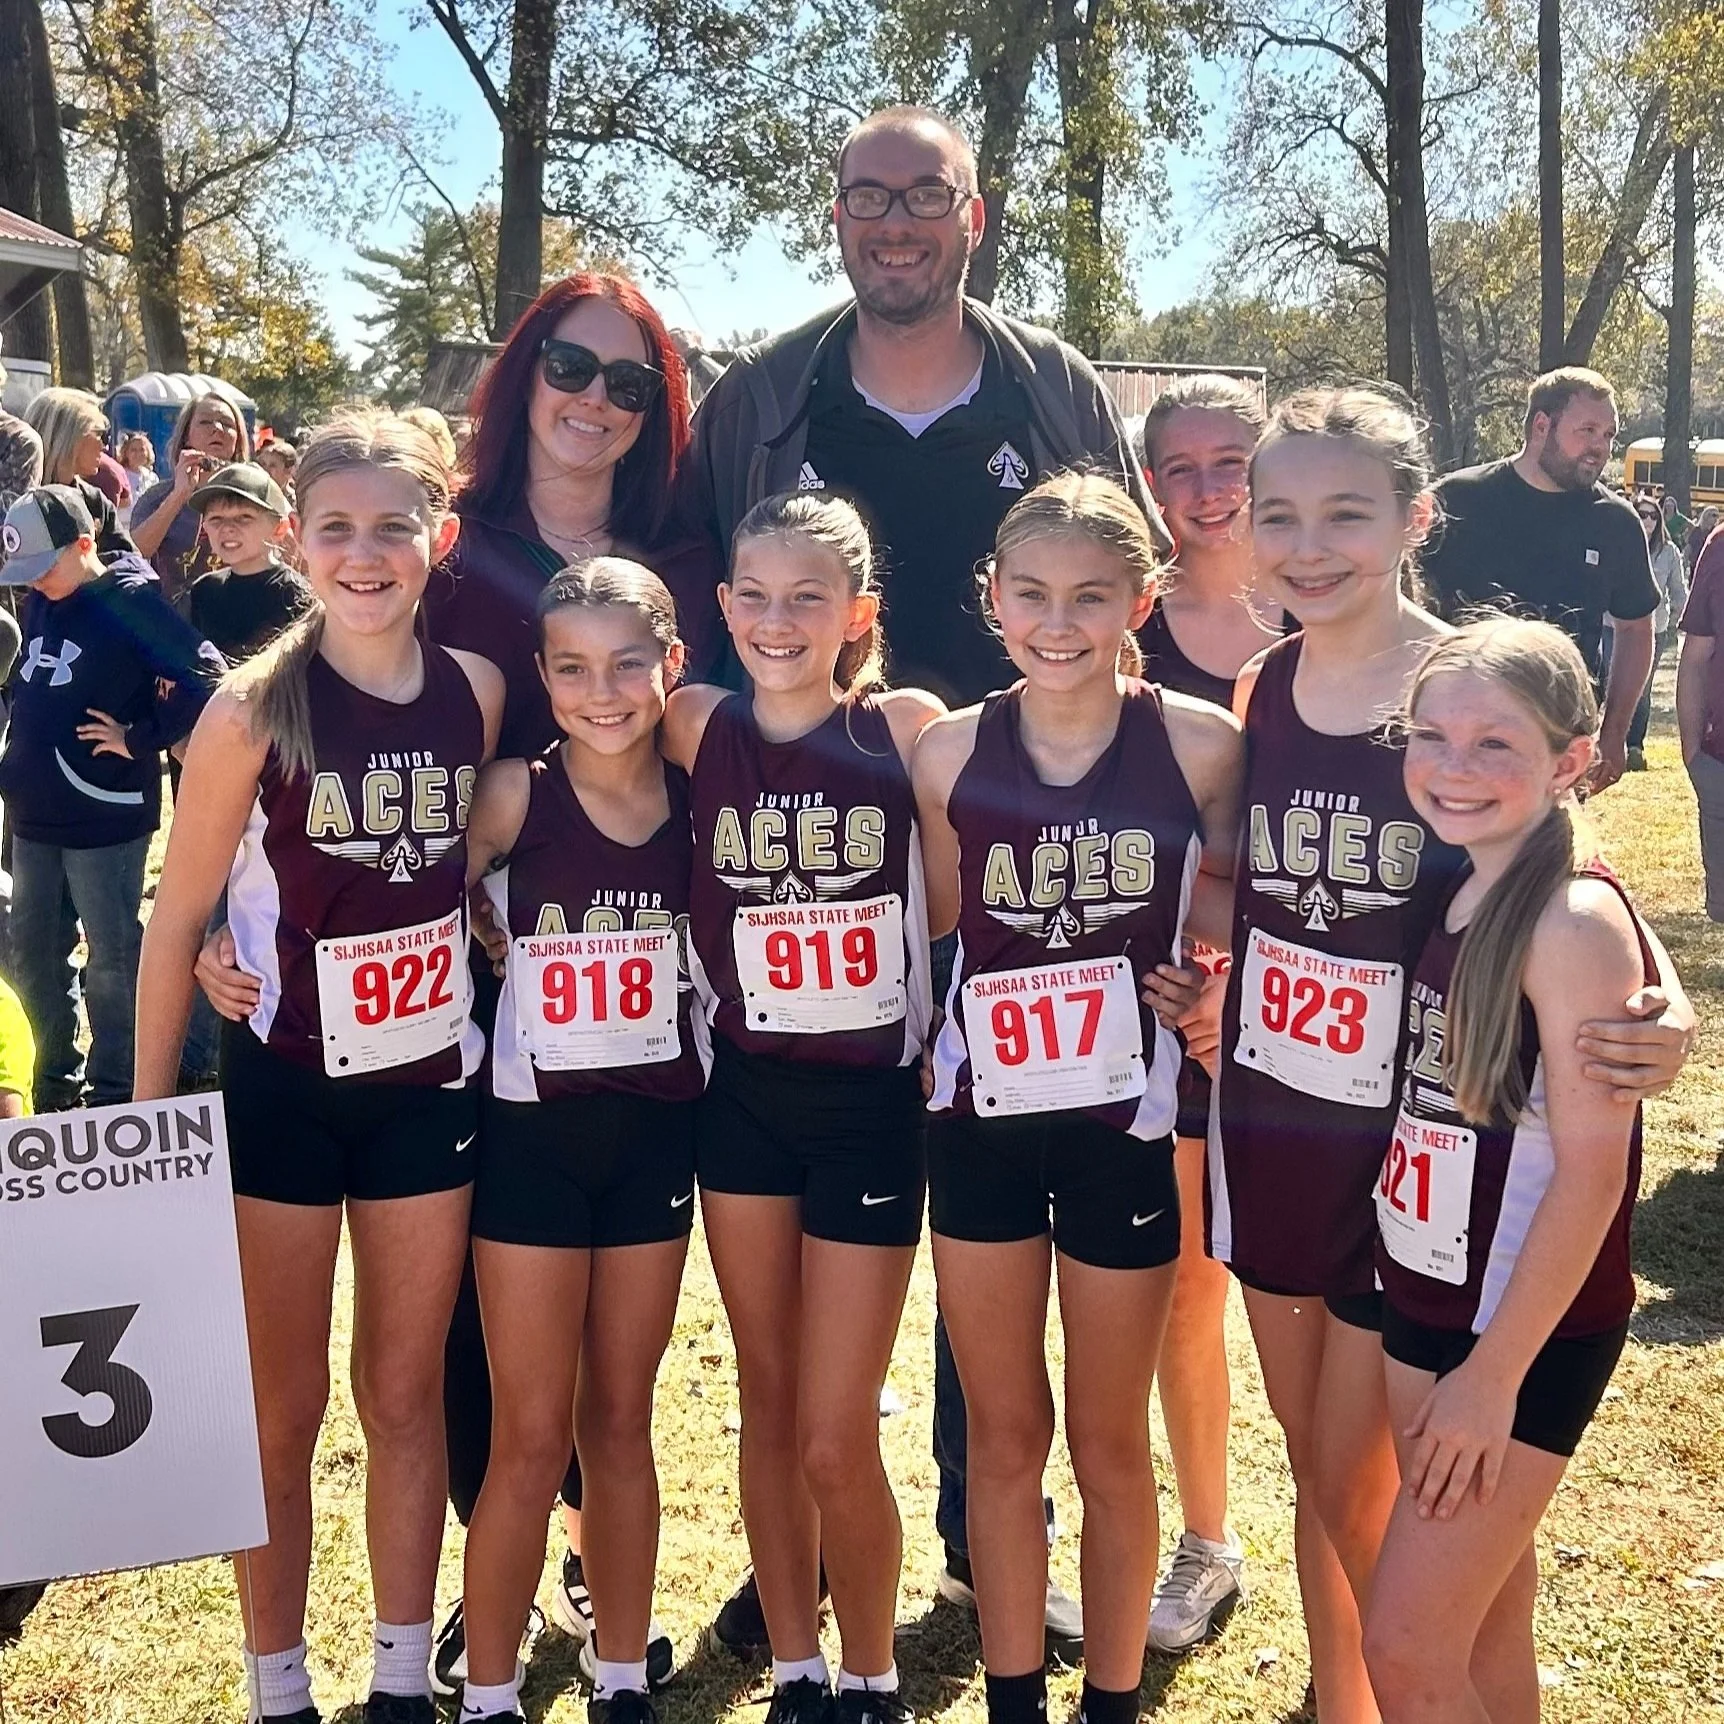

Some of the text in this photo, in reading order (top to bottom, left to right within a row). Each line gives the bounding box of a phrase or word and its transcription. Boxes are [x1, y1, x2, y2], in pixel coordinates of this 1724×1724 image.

[367, 751, 434, 769] JUNIOR
[756, 792, 824, 808] JUNIOR
[1290, 789, 1360, 812] JUNIOR
[713, 806, 885, 872] ACES
[1250, 804, 1425, 890] ACES
[982, 829, 1155, 908] ACES
[591, 889, 662, 909] JUNIOR
[747, 902, 888, 927] SIJHSAA STATE MEET
[333, 918, 458, 961] SIJHSAA STATE MEET
[529, 936, 666, 957] SIJHSAA STATE MEET
[765, 926, 878, 990] 919
[352, 944, 453, 1025] 922
[542, 957, 653, 1024] 918
[974, 965, 1116, 998] SIJHSAA STATE MEET
[1304, 956, 1344, 980] STATE
[1349, 966, 1388, 986] MEET
[991, 989, 1105, 1066] 917
[1261, 966, 1368, 1054] 923
[0, 1106, 213, 1173] QUOIN
[1421, 1128, 1458, 1152] MEET
[56, 1152, 214, 1194] COUNTRY
[40, 1303, 152, 1458] 3
